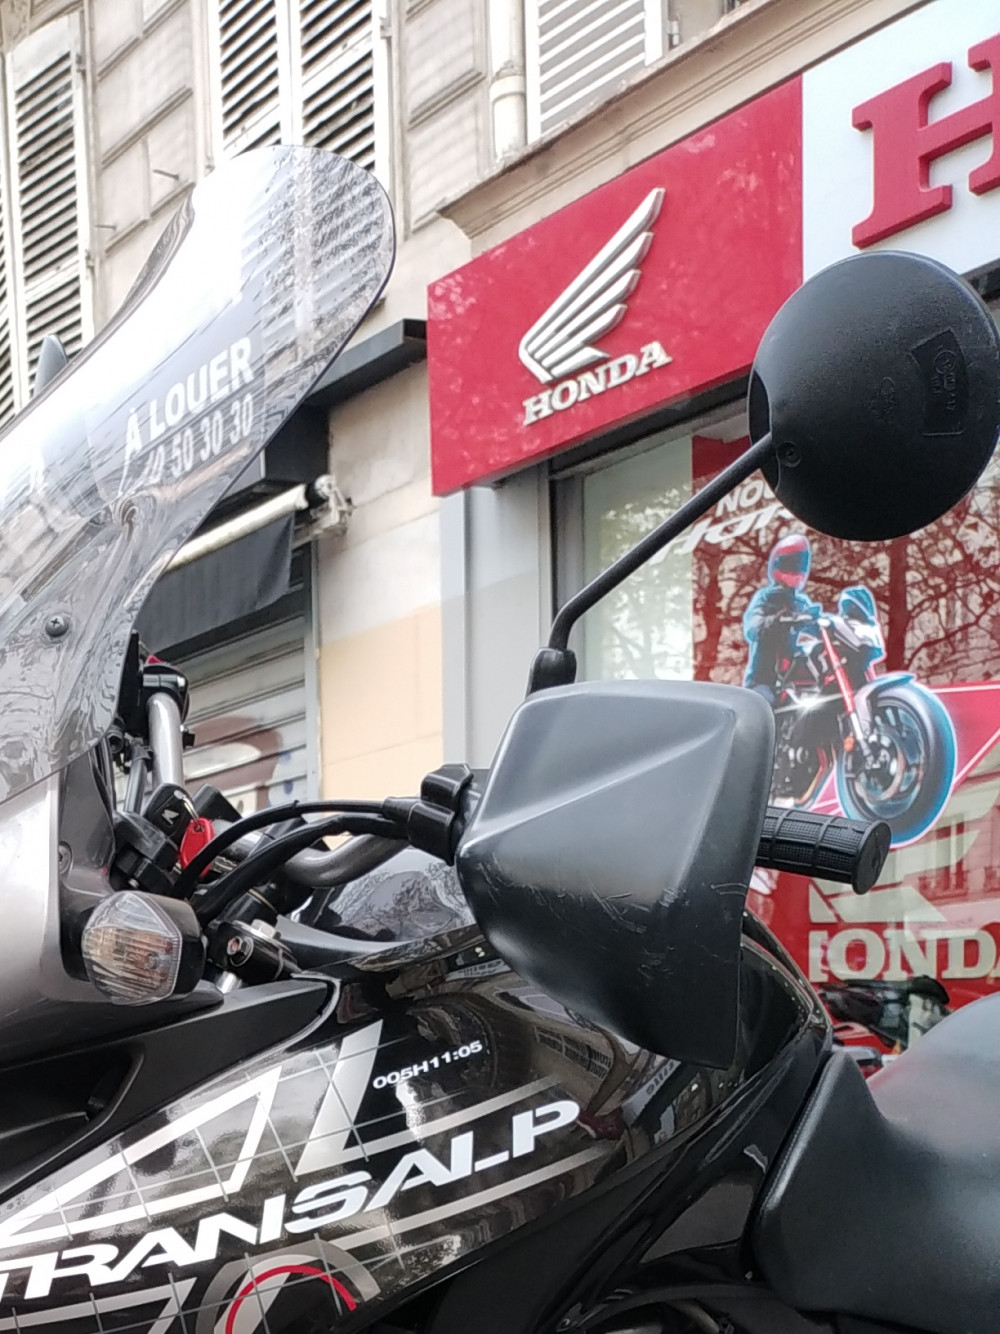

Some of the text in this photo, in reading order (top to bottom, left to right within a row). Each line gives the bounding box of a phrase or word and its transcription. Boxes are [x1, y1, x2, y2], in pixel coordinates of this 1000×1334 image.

[149, 337, 254, 440] LOUER
[522, 340, 673, 426] HONDA
[170, 427, 194, 478] 50
[200, 410, 223, 462] 30
[229, 393, 254, 445] 30
[809, 927, 1000, 982] OND
